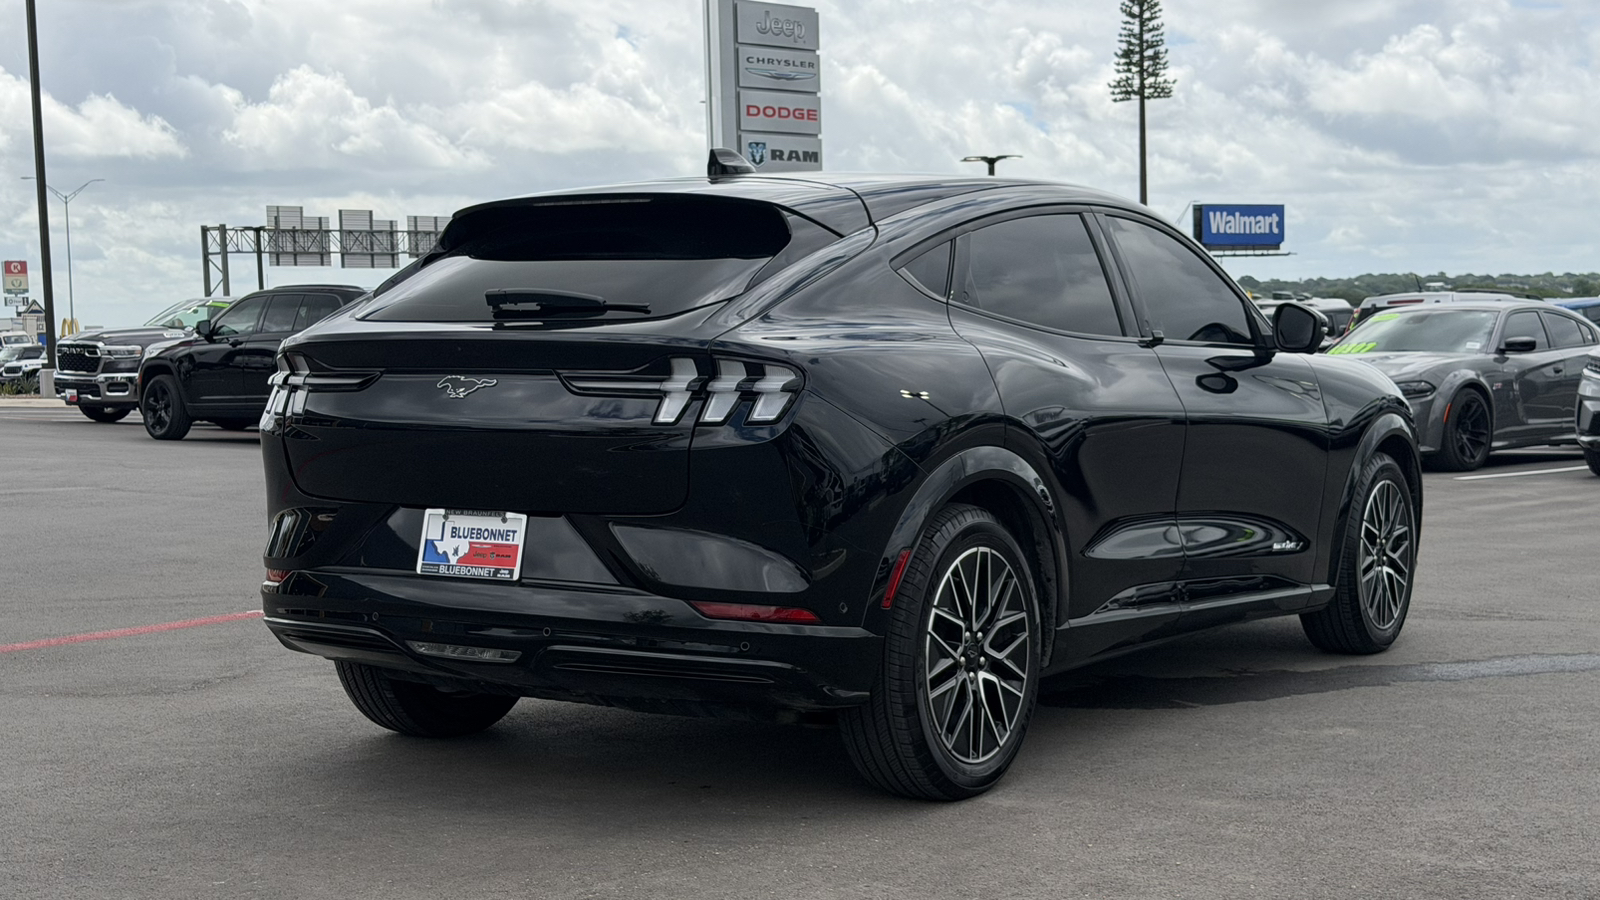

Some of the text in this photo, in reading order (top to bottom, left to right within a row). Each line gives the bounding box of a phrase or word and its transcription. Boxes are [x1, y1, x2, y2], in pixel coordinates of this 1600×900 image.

[756, 10, 806, 43] Jeep
[746, 56, 815, 69] CHRYSLER
[746, 105, 818, 121] DODGE
[770, 149, 819, 163] RAM
[1208, 211, 1279, 234] Walmart
[450, 526, 518, 542] BLUEBONNET
[439, 565, 496, 577] BLUEBONNET
